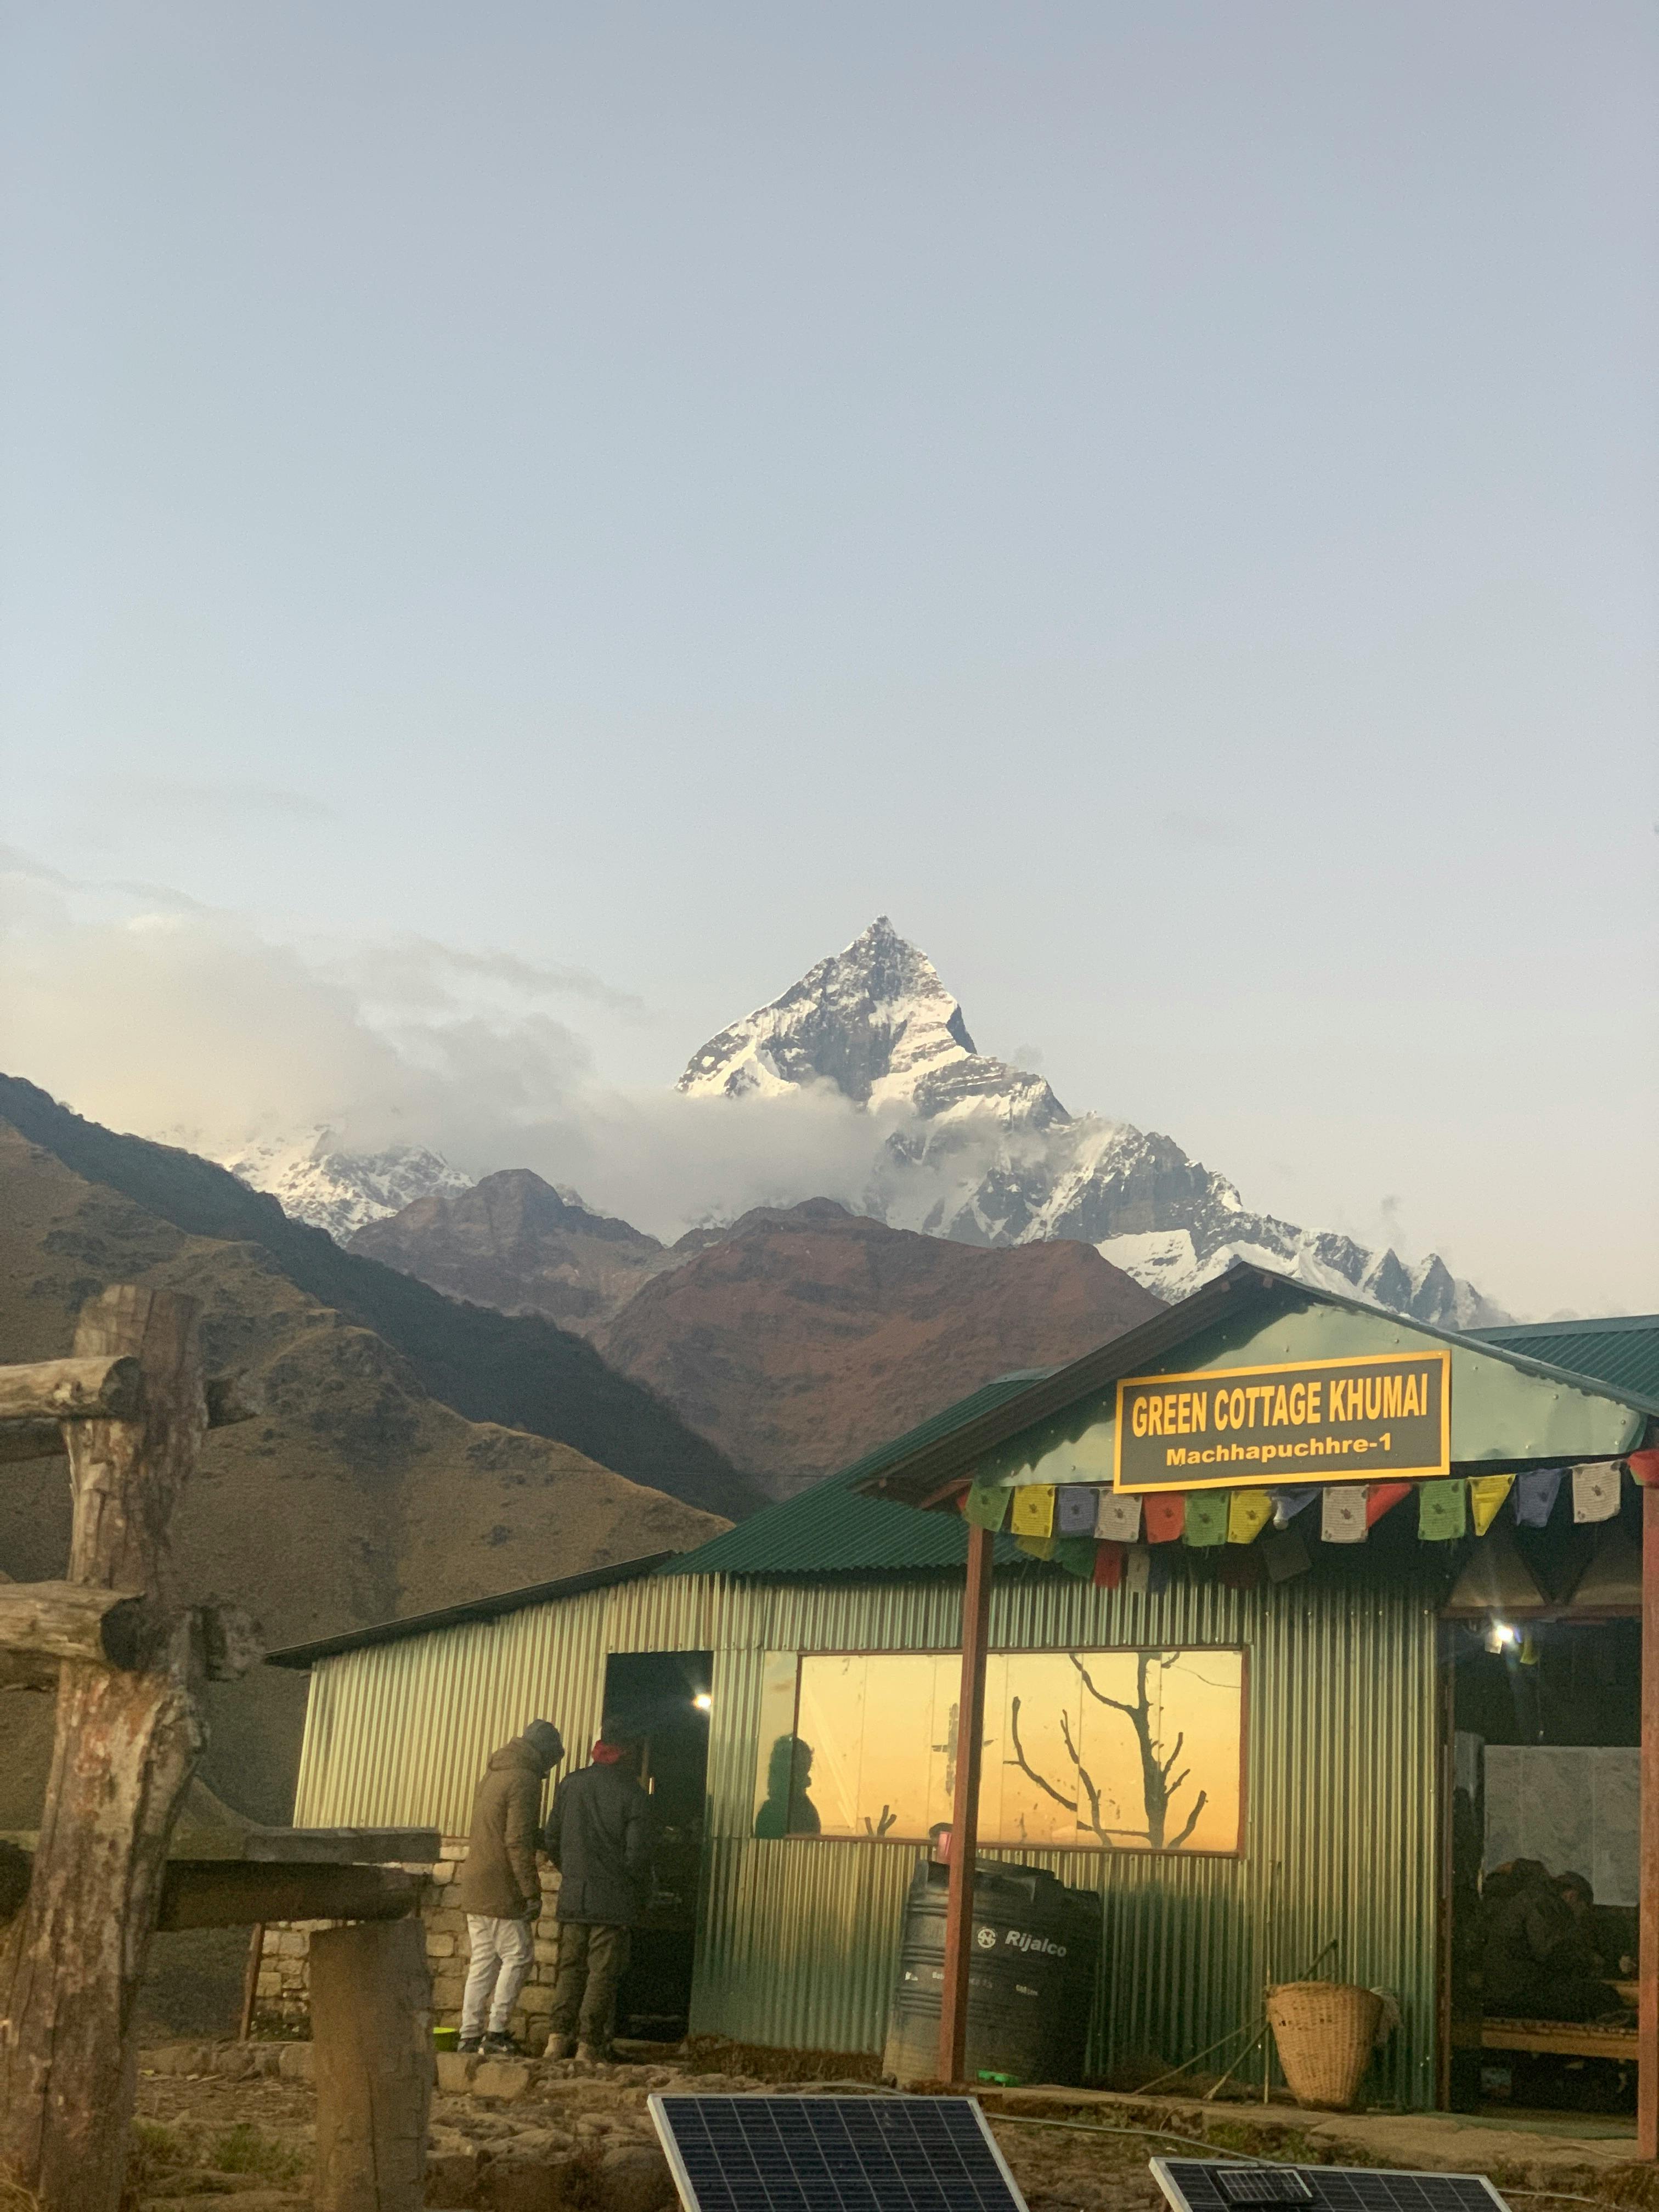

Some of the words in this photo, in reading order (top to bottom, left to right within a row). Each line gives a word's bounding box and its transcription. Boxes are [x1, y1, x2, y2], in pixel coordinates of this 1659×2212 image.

[1132, 1392, 1207, 1437] GREEN
[1214, 1382, 1321, 1431] COTTAGE
[1329, 1373, 1427, 1422] KHUMAI
[1166, 1433, 1391, 1466] Machhapuchhre-1
[1005, 1930, 1066, 1957] Rijalco
